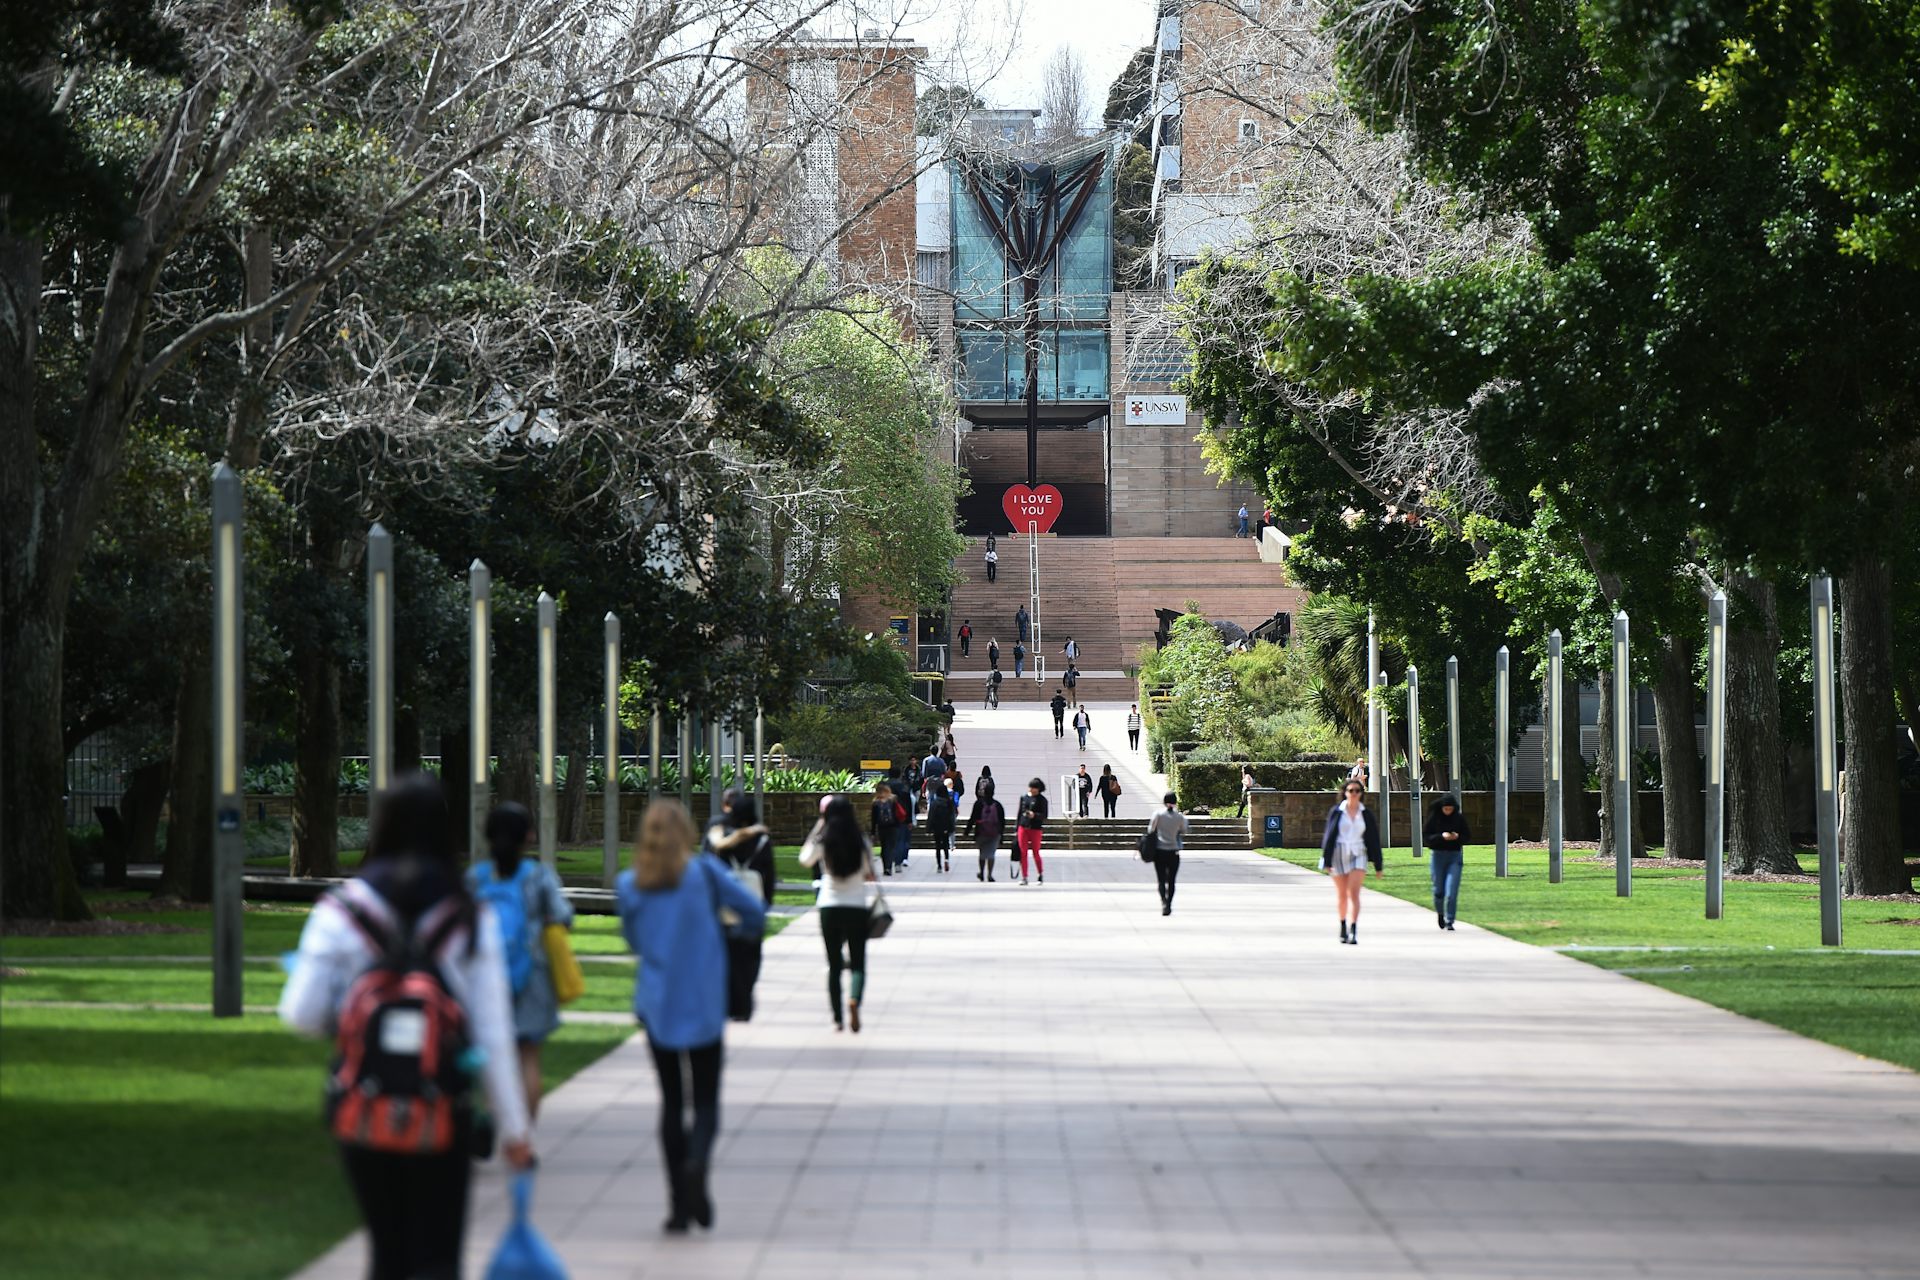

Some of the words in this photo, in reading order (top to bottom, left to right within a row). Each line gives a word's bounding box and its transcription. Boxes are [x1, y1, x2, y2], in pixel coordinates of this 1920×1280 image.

[1145, 402, 1181, 412] UNSW
[1013, 495, 1017, 503] I
[1020, 495, 1052, 503] LOVE
[1021, 506, 1044, 515] YOU
